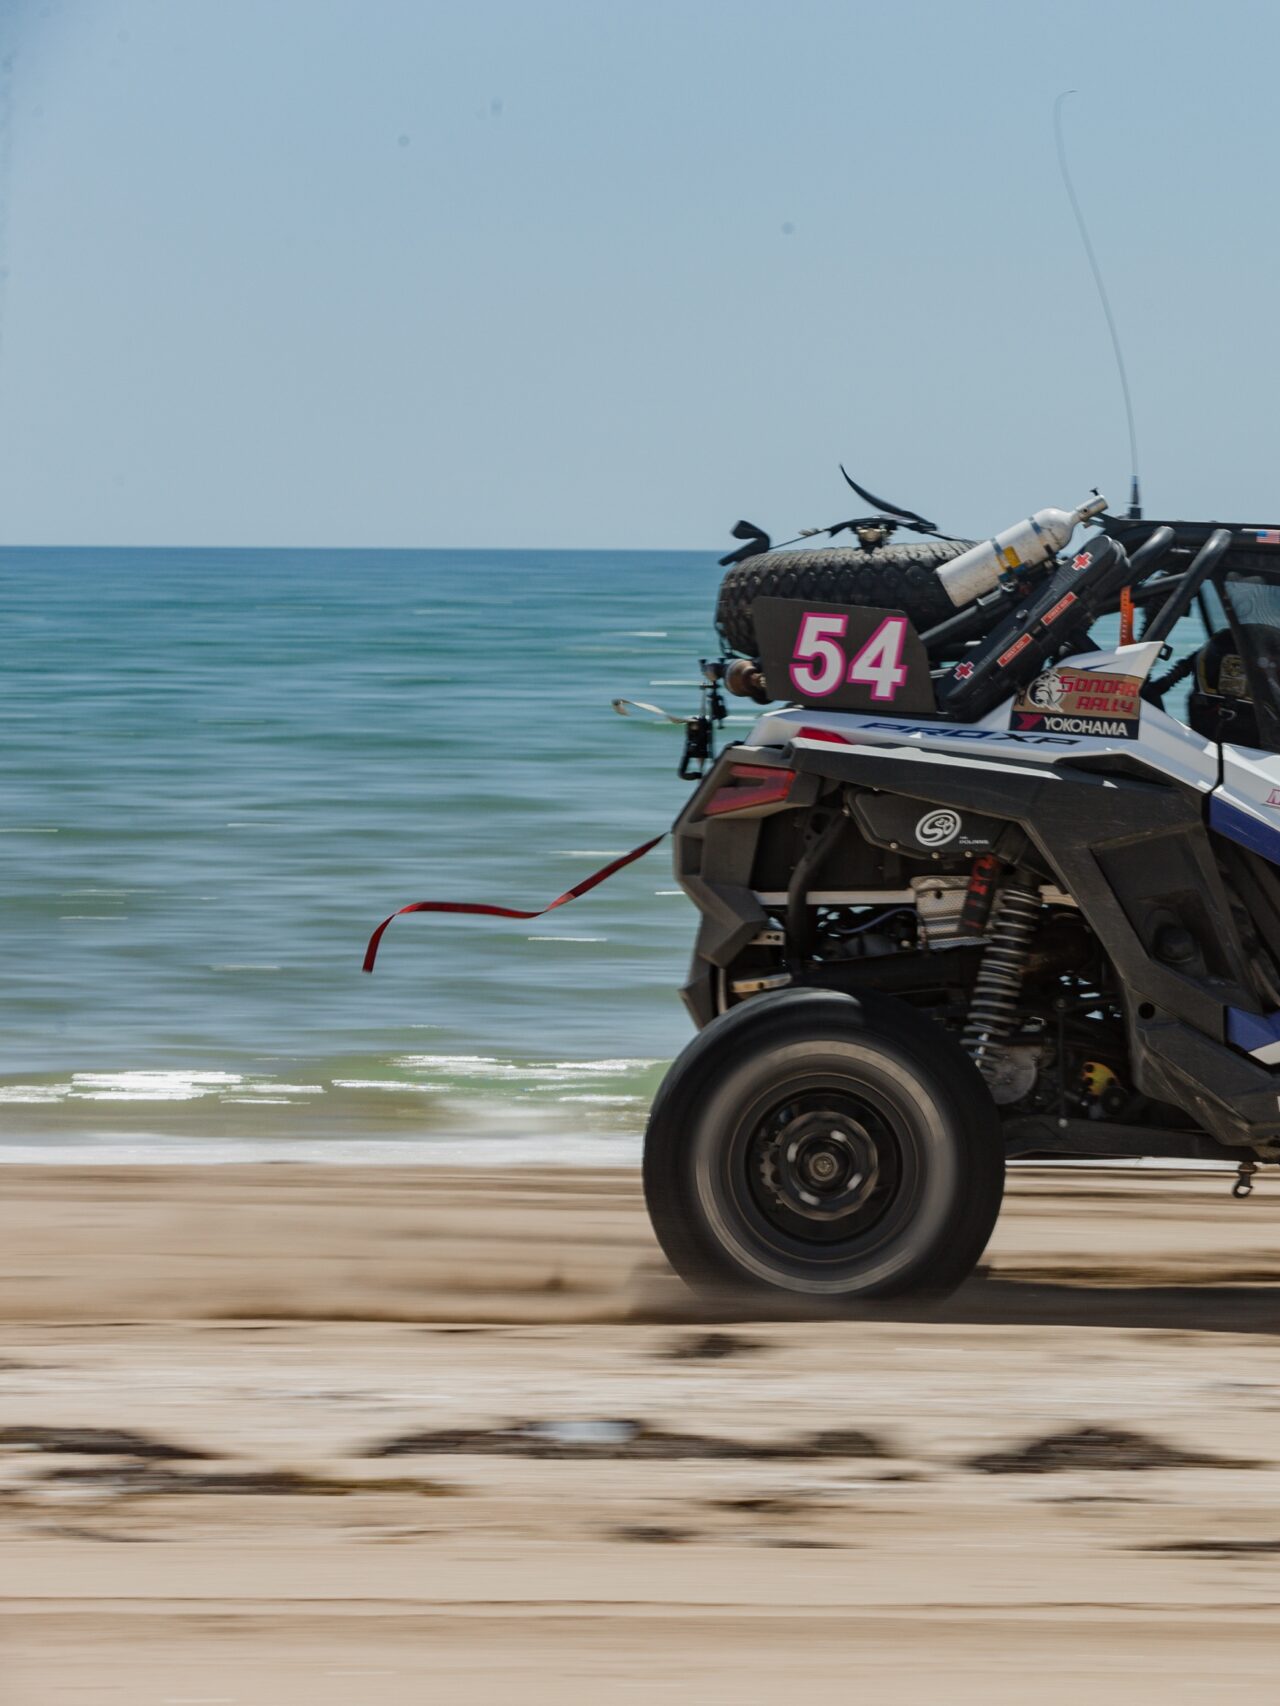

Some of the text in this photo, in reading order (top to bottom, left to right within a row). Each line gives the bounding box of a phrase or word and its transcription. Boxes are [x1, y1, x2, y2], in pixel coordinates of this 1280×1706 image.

[789, 611, 908, 701] 54
[1075, 696, 1136, 713] RALLY
[858, 722, 1082, 746] PRO XP
[1043, 716, 1129, 736] YOKOHAMA
